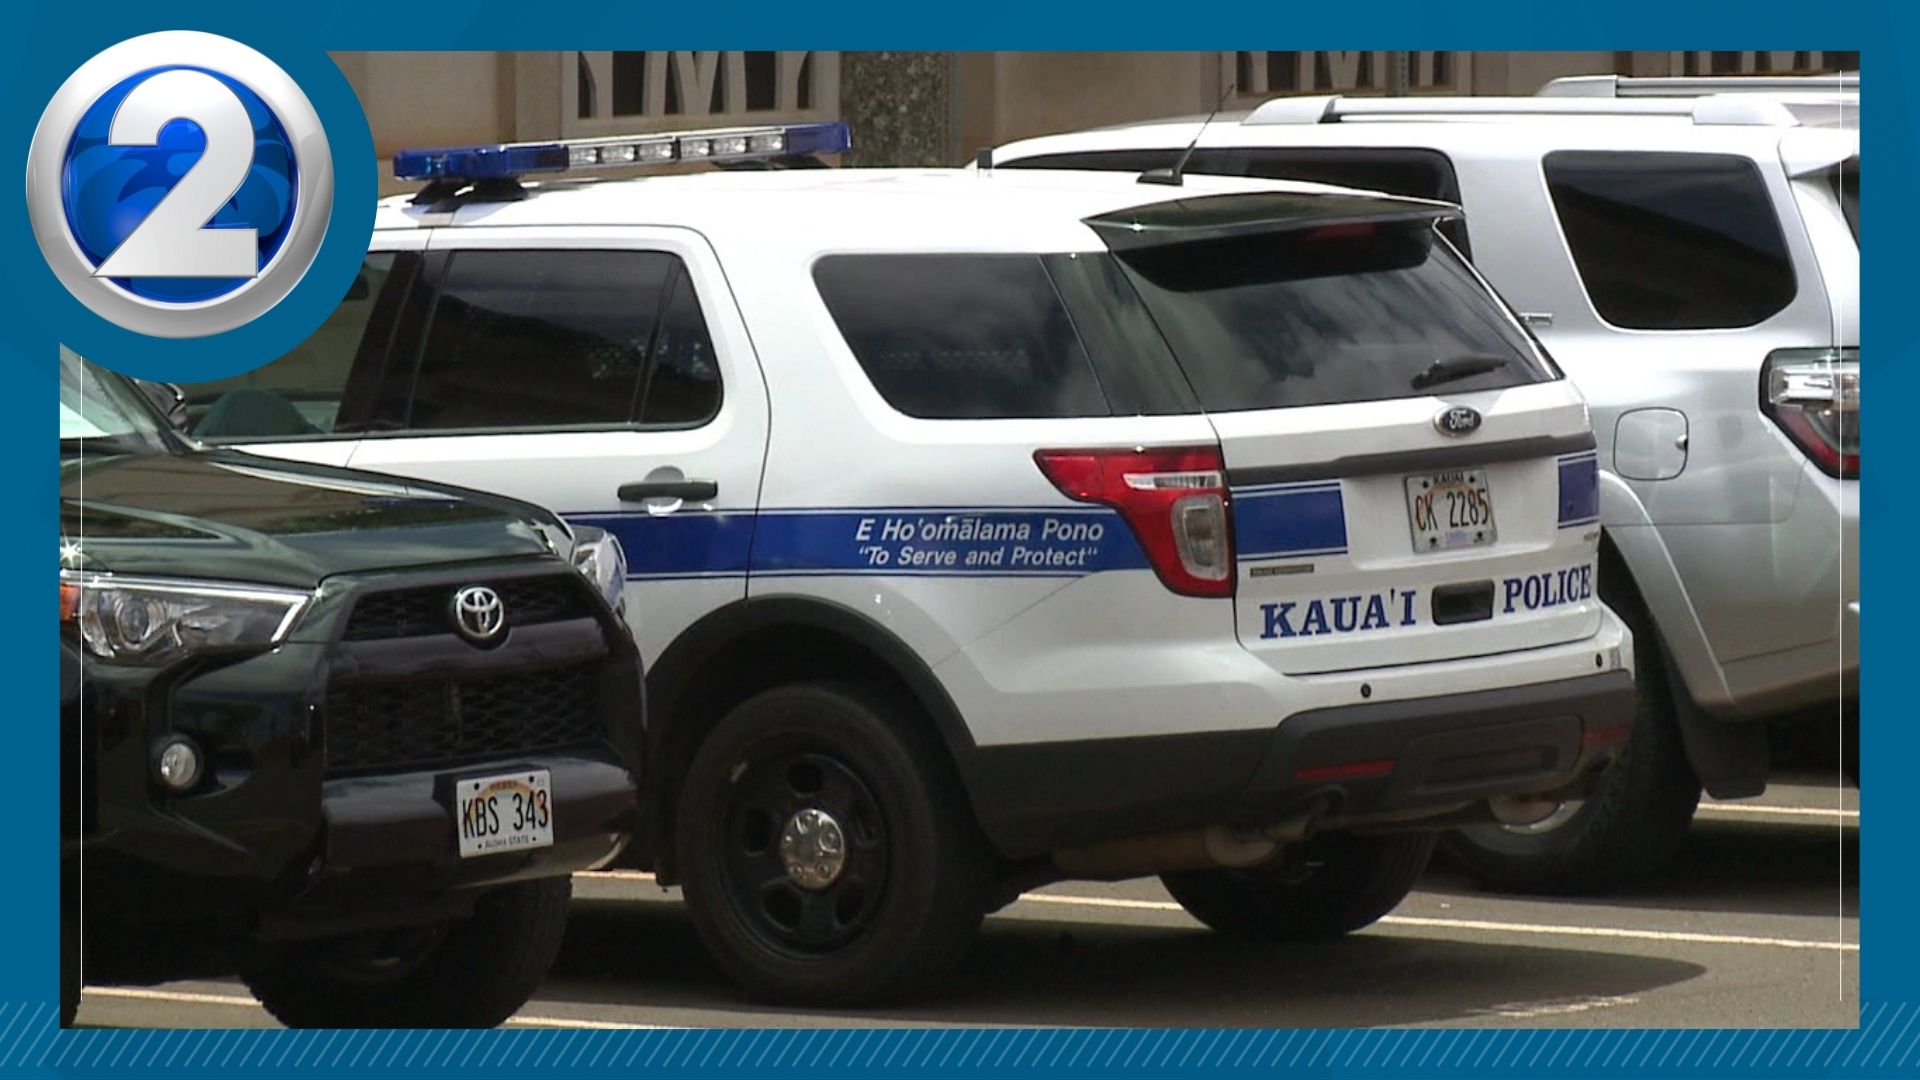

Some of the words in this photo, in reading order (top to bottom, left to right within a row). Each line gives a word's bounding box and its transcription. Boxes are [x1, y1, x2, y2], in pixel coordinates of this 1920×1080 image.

[1449, 410, 1474, 429] Ford
[1415, 495, 1438, 532] CK
[1446, 488, 1489, 528] 2285
[855, 518, 875, 541] E
[1041, 518, 1104, 541] Pono
[898, 546, 957, 565] Serve
[965, 546, 1003, 565] and
[1260, 587, 1416, 639] KAUA'I
[1503, 564, 1592, 613] POLICE
[462, 796, 499, 839] KBS
[512, 789, 549, 831] 343
[509, 836, 530, 845] STATE
